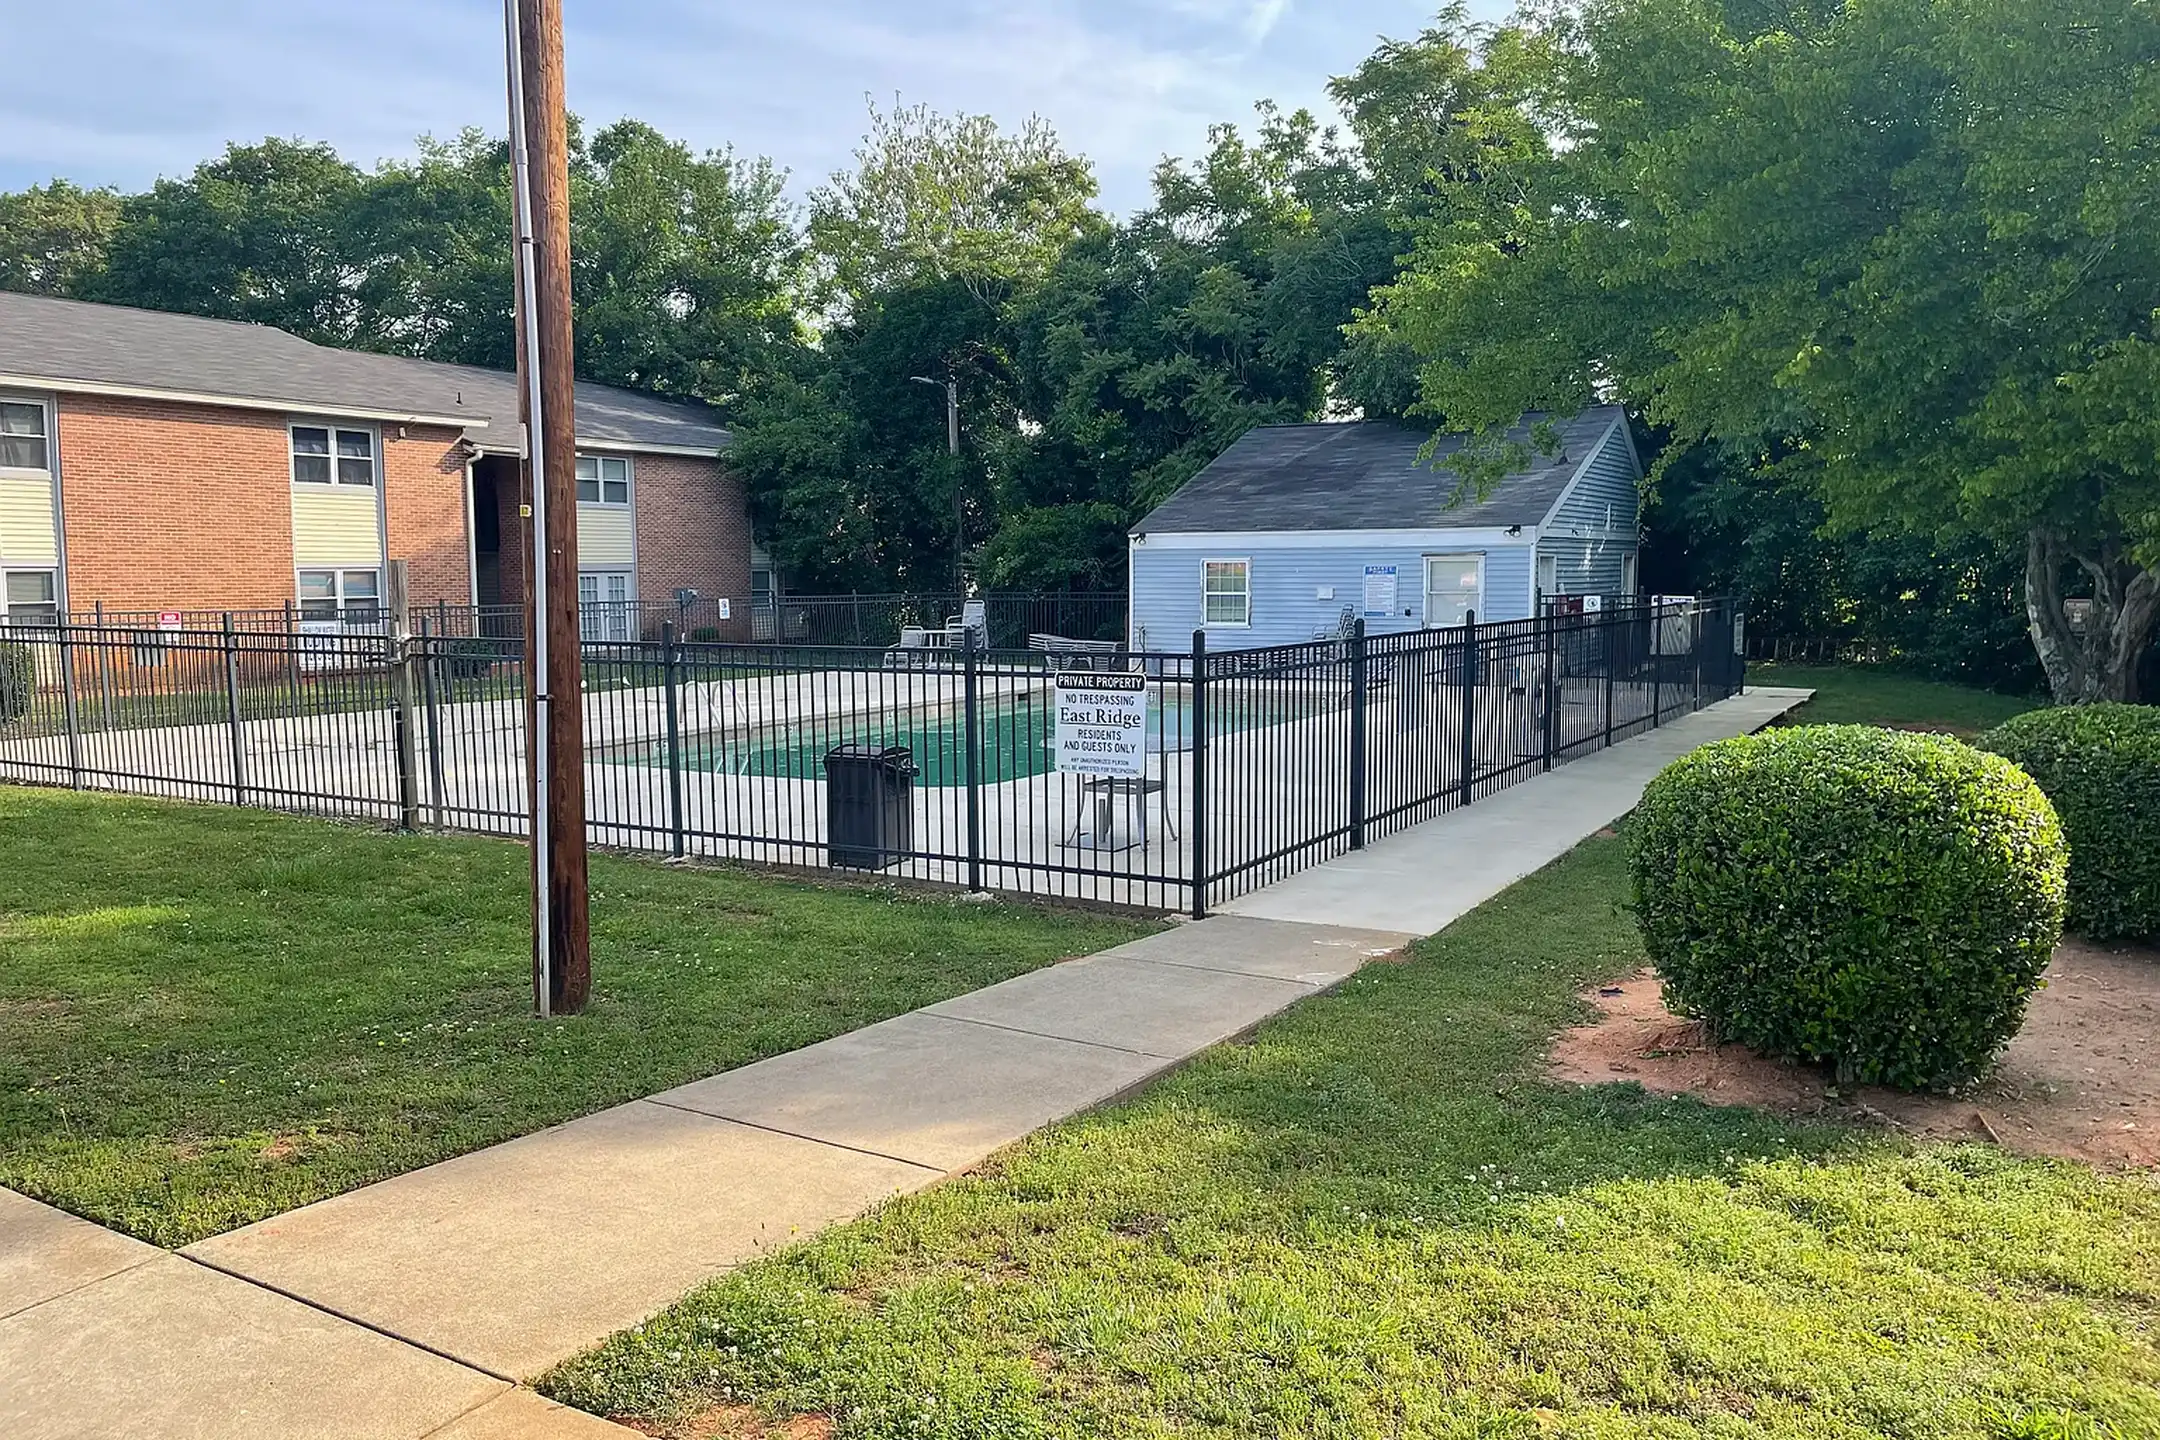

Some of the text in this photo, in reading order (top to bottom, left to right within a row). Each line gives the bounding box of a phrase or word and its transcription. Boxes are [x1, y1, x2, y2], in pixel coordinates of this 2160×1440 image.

[1058, 675, 1142, 689] PRIVATE PROPERTY
[1065, 693, 1135, 706] NO TRESPASSING
[1060, 707, 1141, 729] East Ridge
[1077, 729, 1122, 741] RESIDENTS
[1063, 740, 1137, 754] AND GUESTS ONLY
